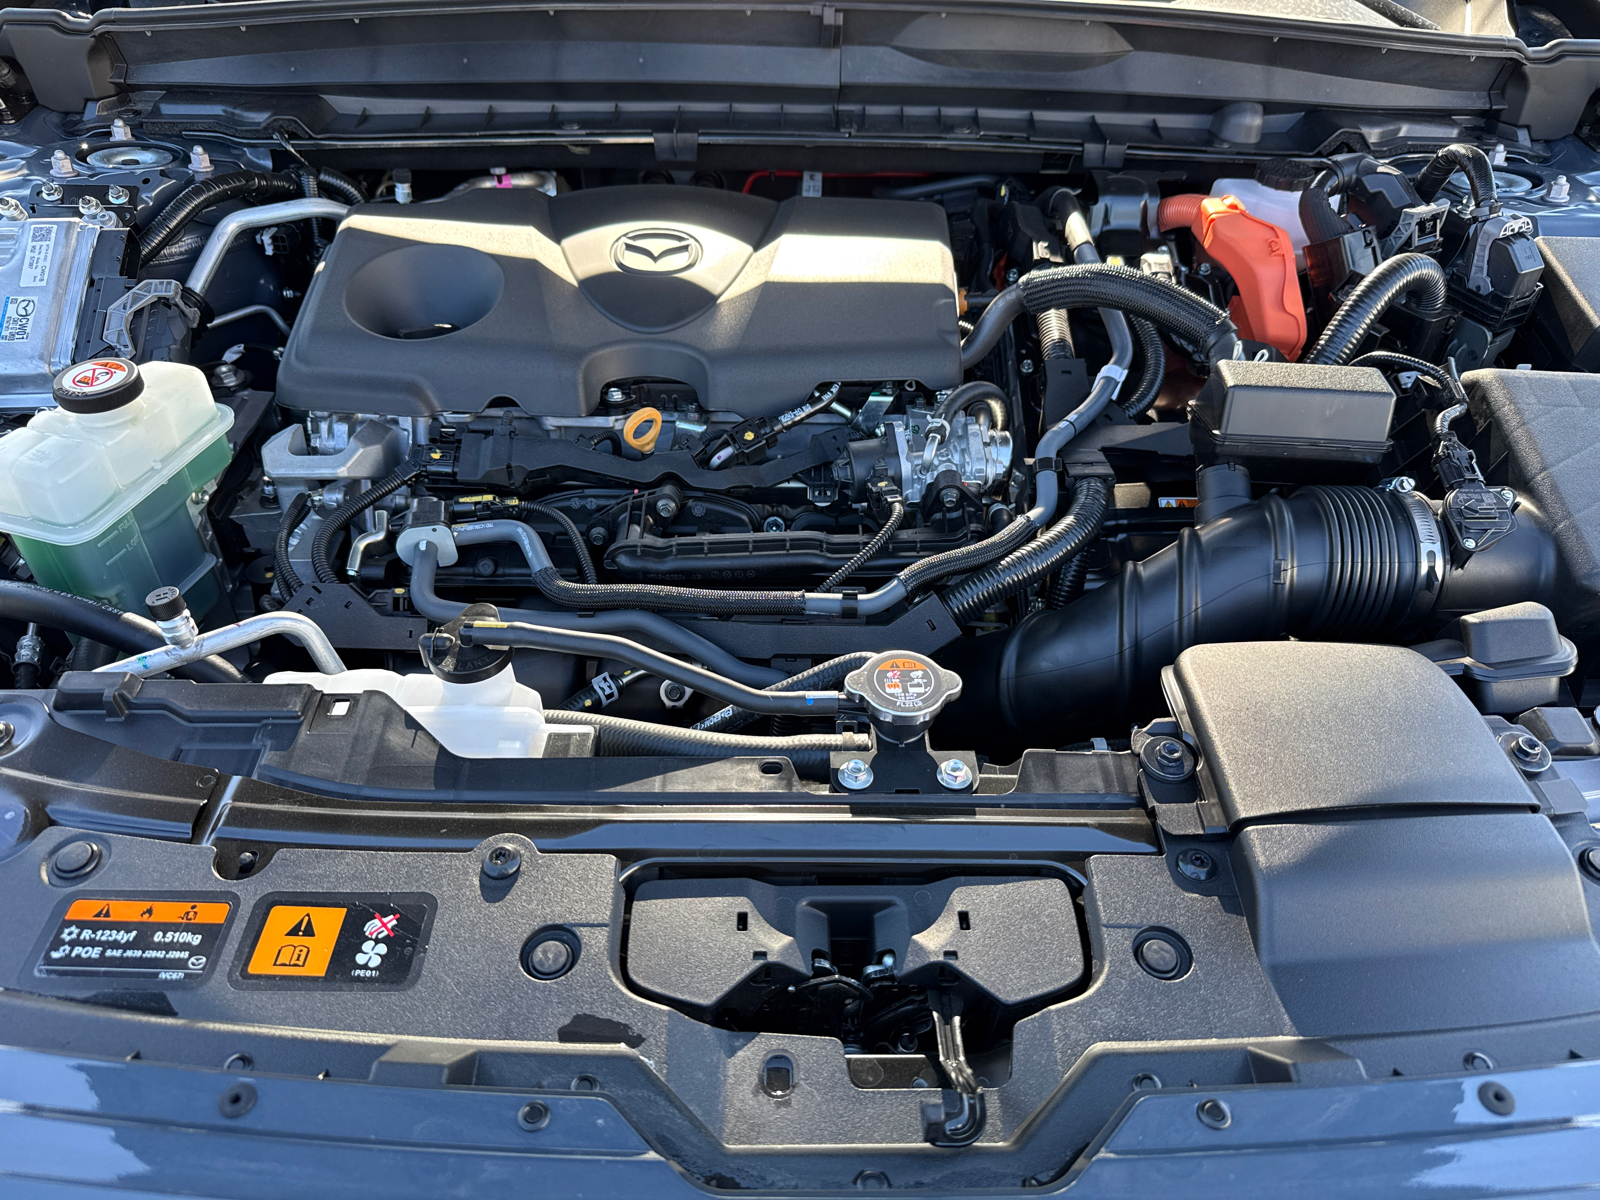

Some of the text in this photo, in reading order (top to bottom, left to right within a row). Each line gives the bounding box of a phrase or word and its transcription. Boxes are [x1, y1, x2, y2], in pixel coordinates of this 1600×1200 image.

[15, 317, 30, 340] CW01
[79, 929, 203, 946] R-1234yf 0.510kg
[71, 946, 103, 959] POE
[104, 948, 124, 957] SAE
[123, 949, 142, 958] J639
